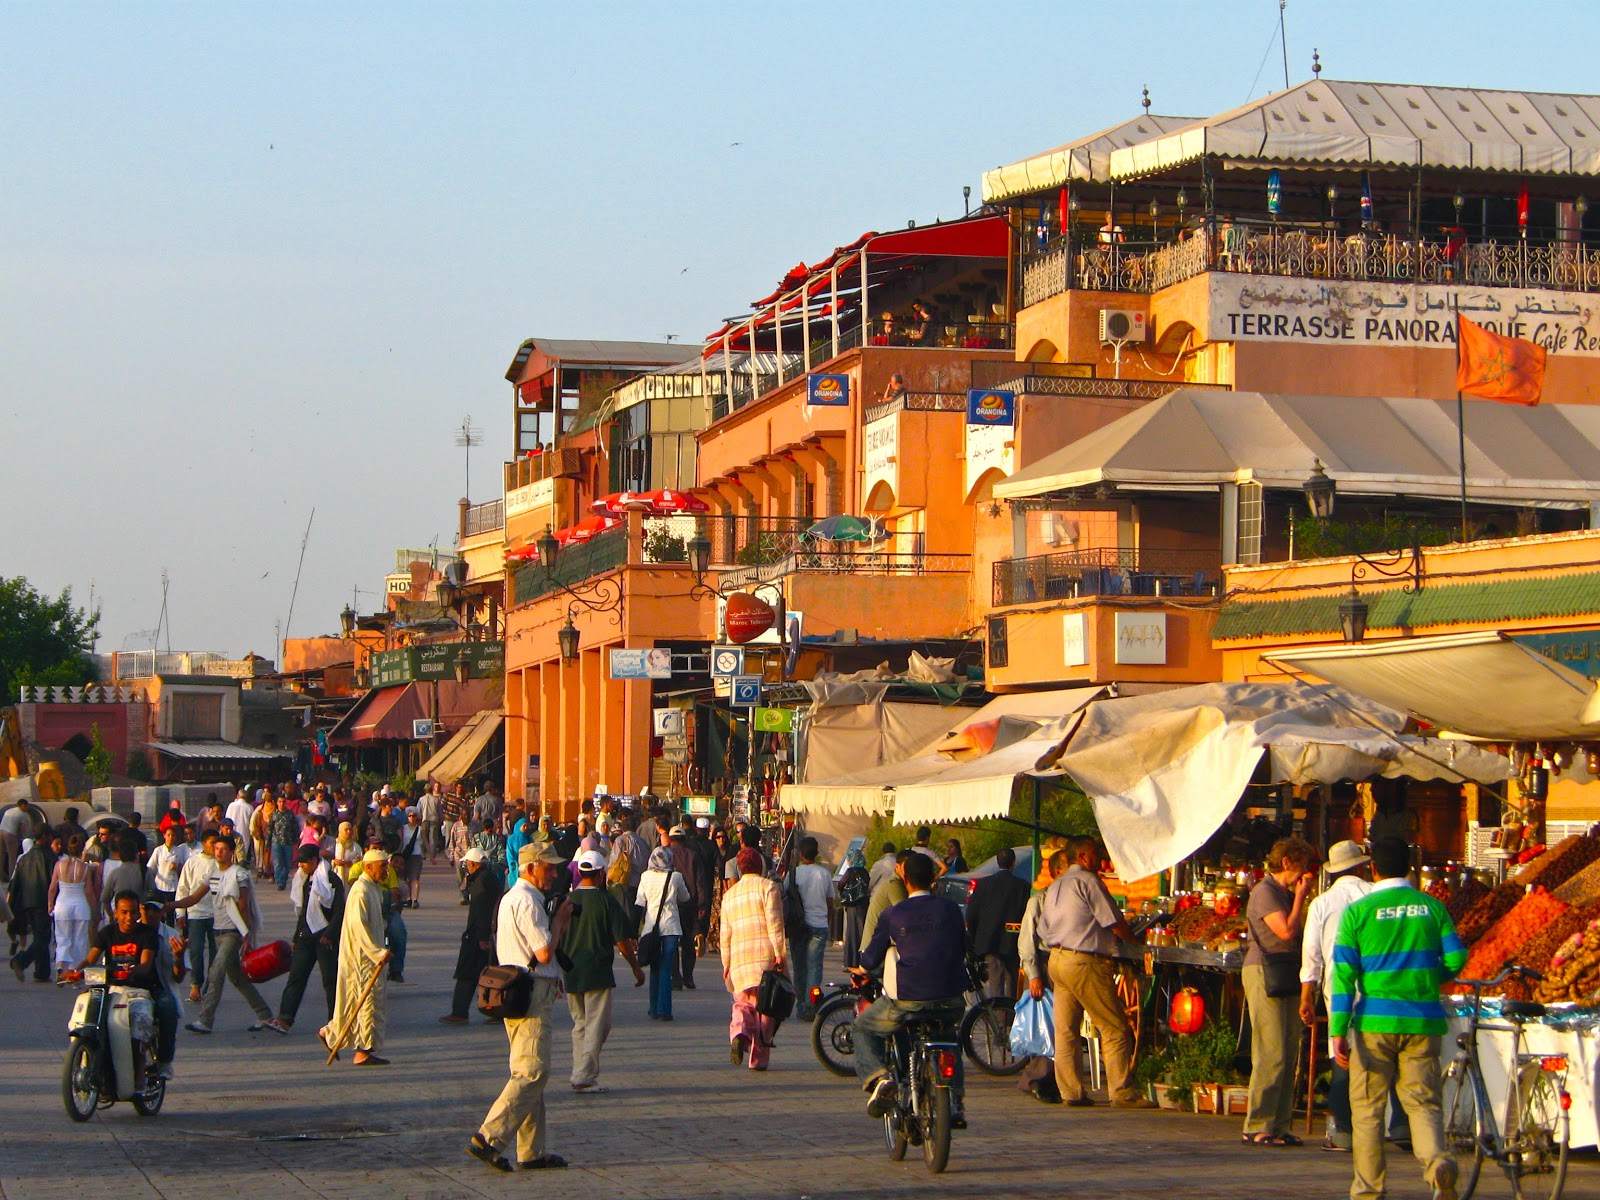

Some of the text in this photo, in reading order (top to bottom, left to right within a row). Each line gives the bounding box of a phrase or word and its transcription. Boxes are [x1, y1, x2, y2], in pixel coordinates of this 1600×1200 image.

[1227, 313, 1355, 341] TERRASSE
[1571, 325, 1600, 351] Re
[814, 389, 843, 397] ORANGINA
[975, 407, 1008, 416] ORANGINA
